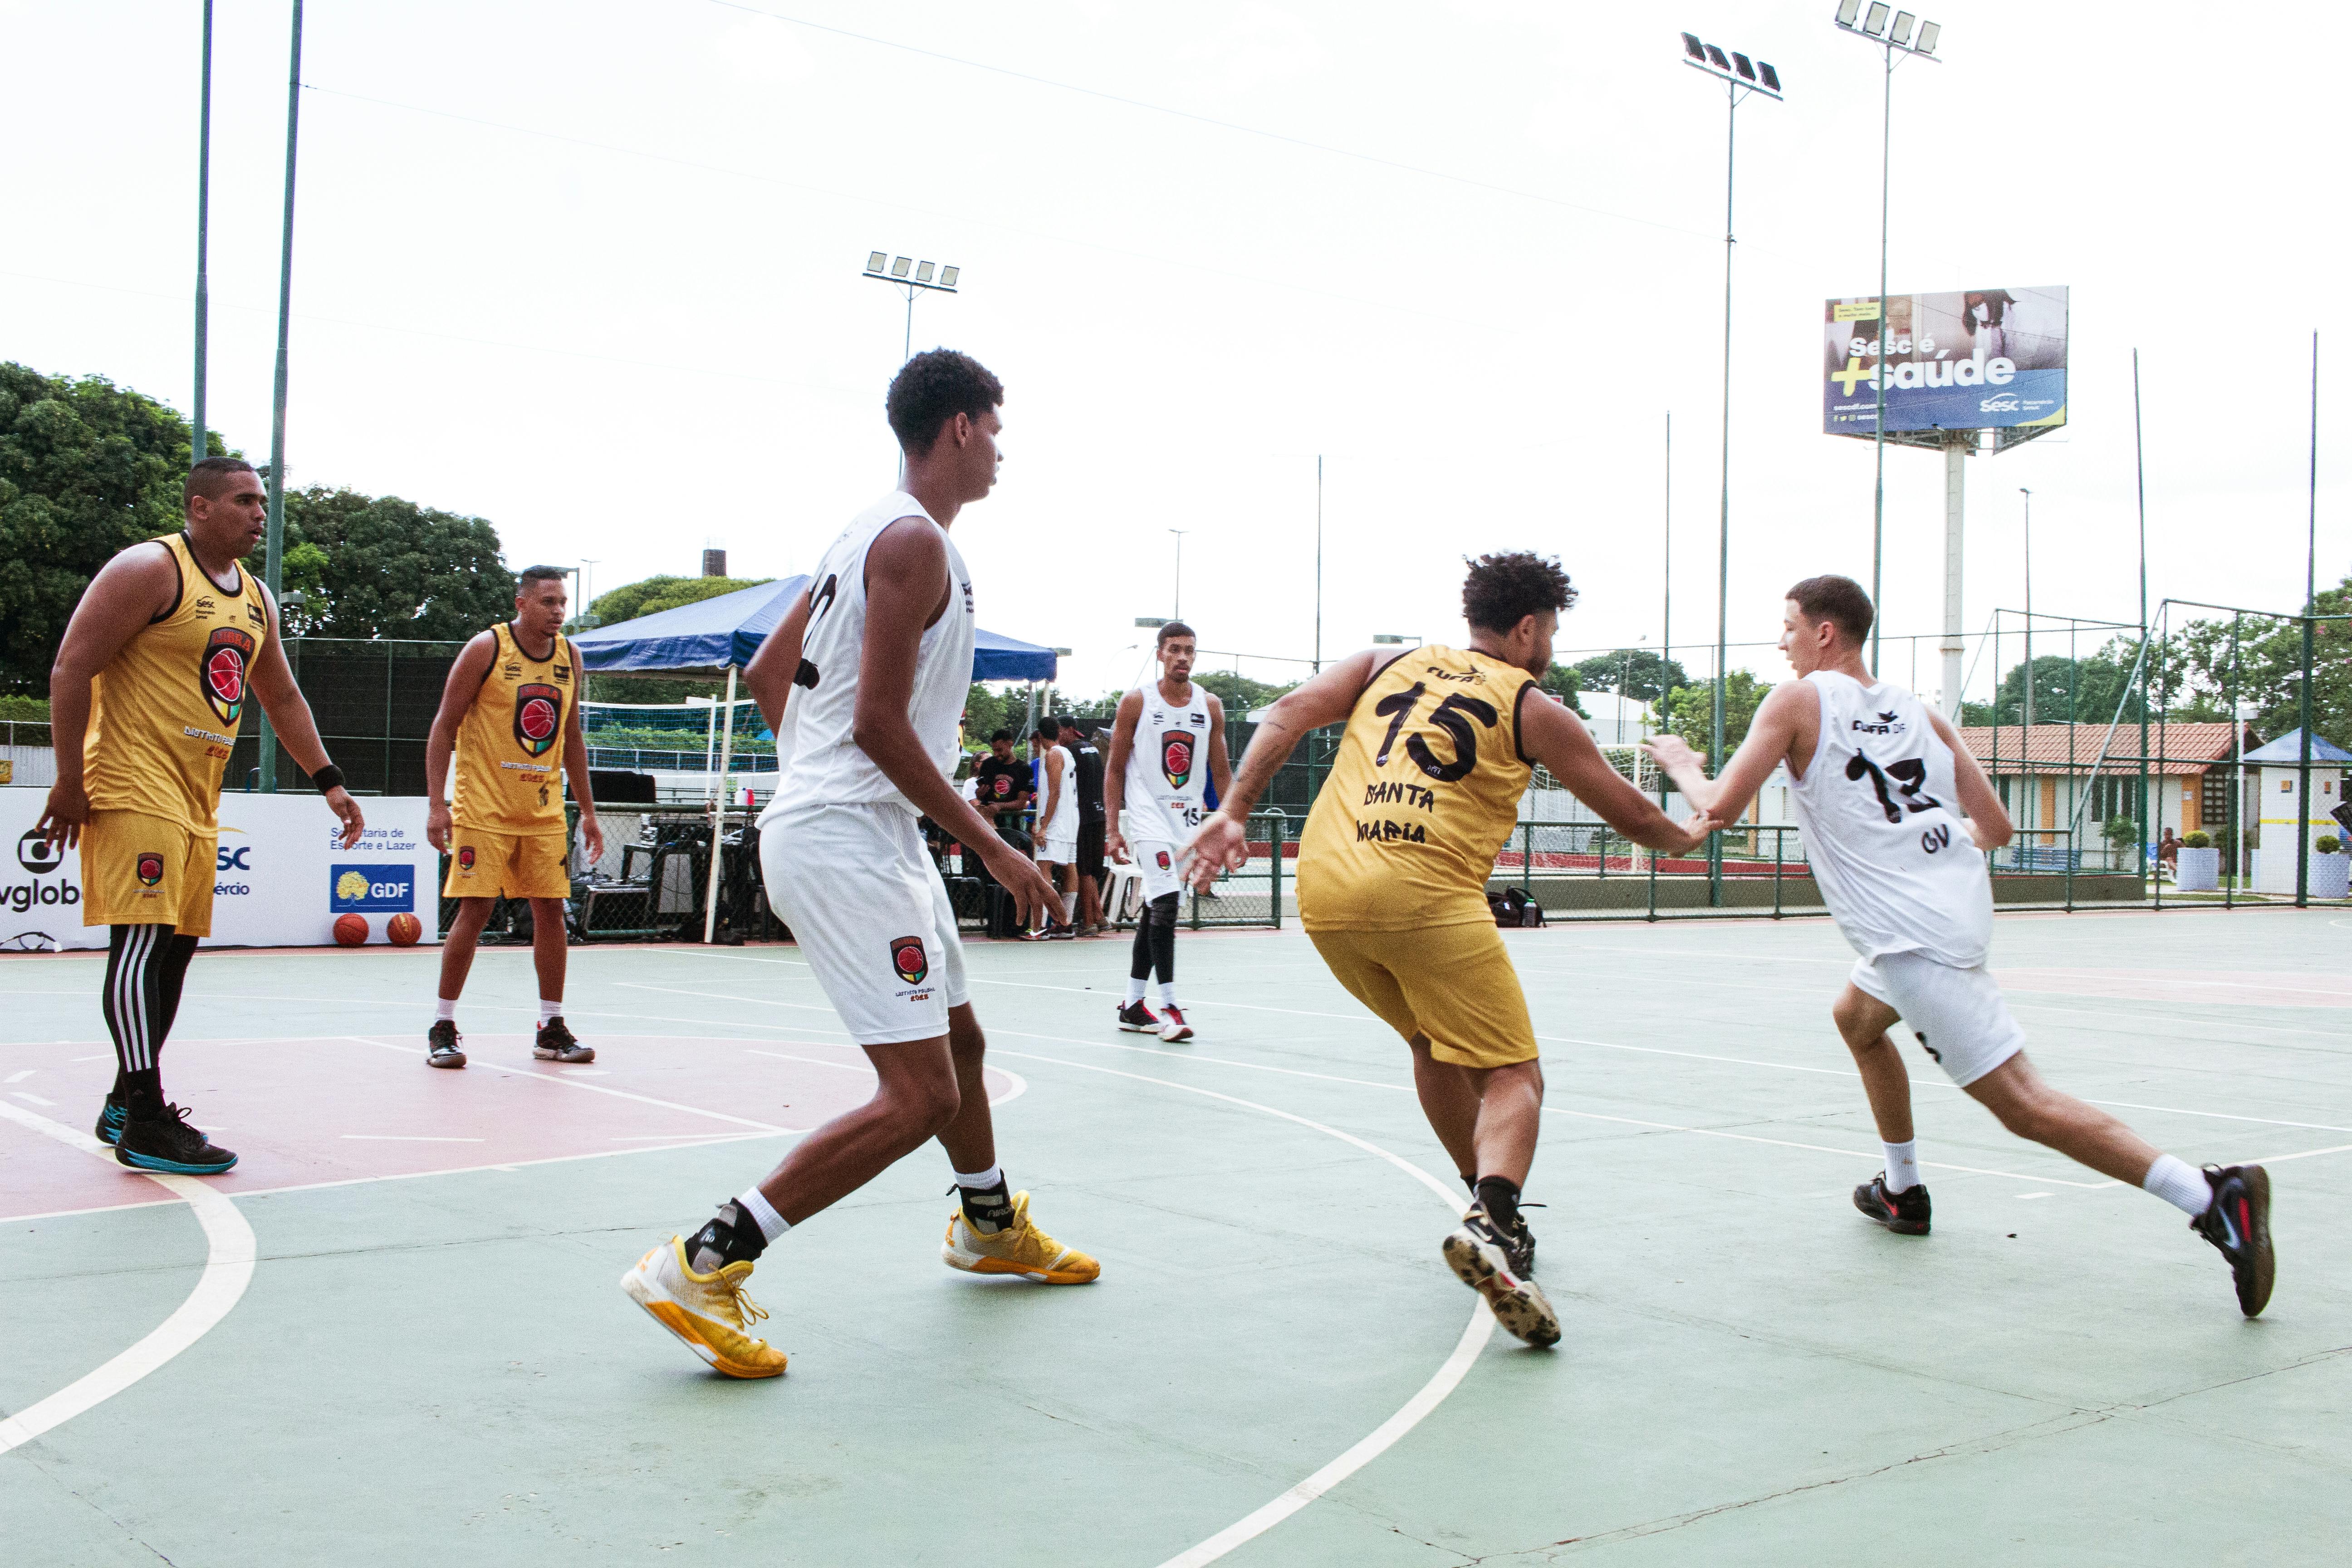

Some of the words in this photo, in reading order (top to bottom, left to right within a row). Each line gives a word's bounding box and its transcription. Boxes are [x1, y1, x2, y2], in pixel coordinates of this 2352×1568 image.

[1848, 337, 1912, 357] Sesc
[1920, 334, 1935, 353] é
[1376, 681, 1498, 782] 15
[1364, 781, 1434, 813] SANTA
[1846, 748, 1943, 824] 12
[391, 828, 404, 838] de
[1922, 824, 1950, 854] GV
[330, 840, 373, 850] Esorte
[387, 841, 416, 850] Lazer
[214, 882, 250, 895] ércio
[371, 882, 409, 898] GDF
